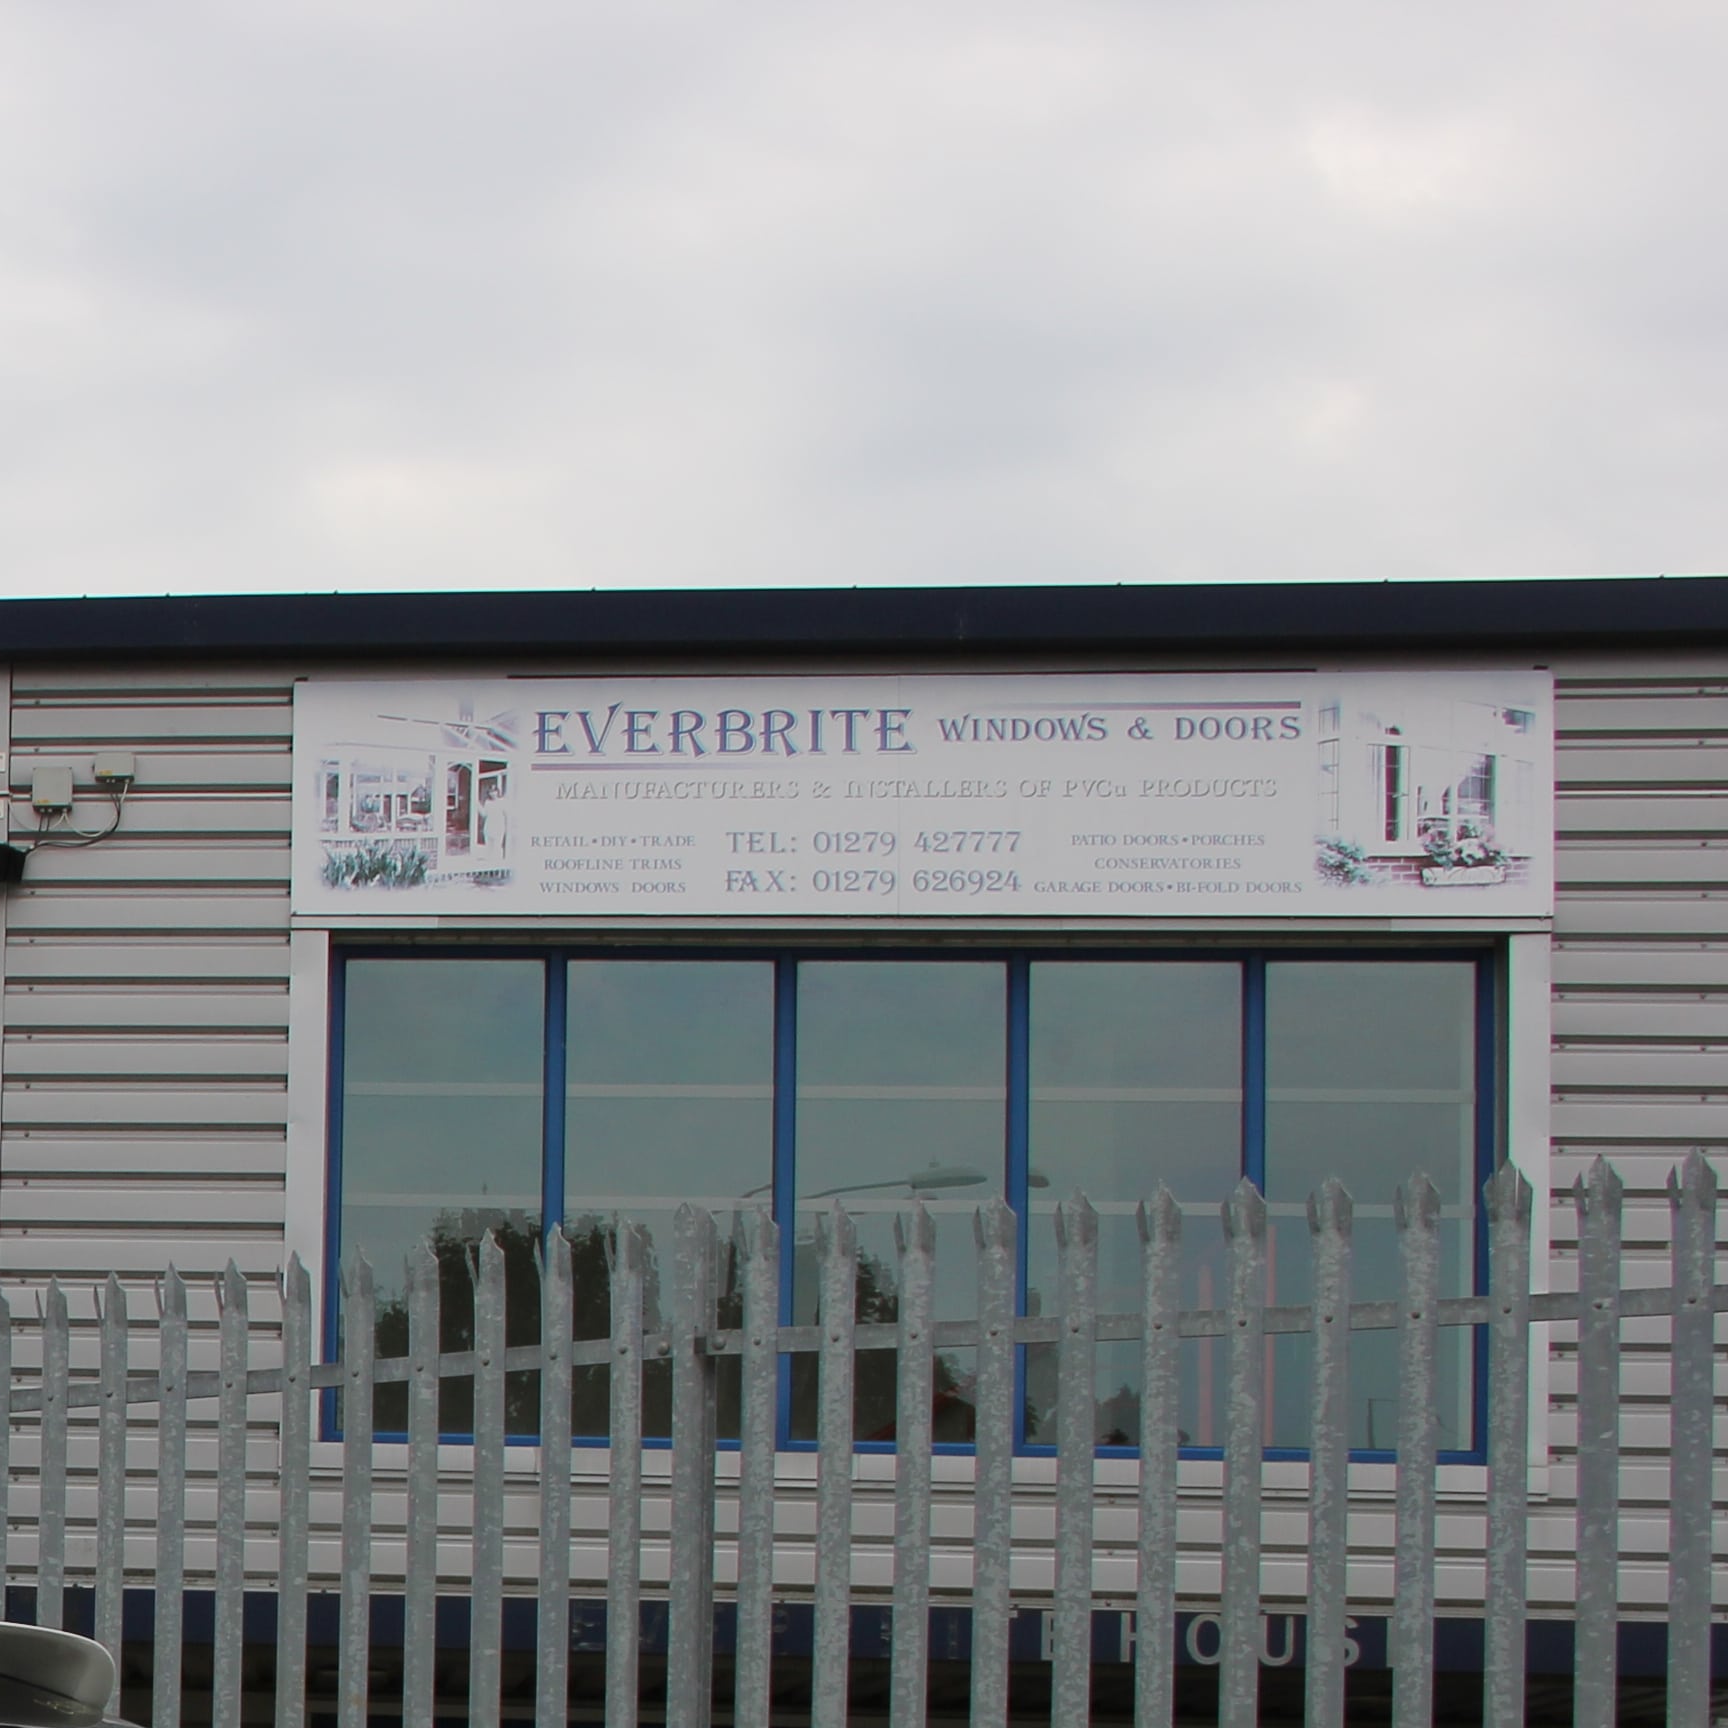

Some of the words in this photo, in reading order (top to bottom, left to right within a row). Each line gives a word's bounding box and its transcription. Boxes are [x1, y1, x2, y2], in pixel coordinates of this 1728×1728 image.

[533, 701, 915, 757] EVERBRITE
[938, 712, 1108, 742] WINDOWS
[1127, 715, 1153, 741] &
[1175, 715, 1302, 742] DOORS
[556, 781, 800, 800] MANUFACTURERS
[812, 780, 831, 799] &
[845, 778, 1008, 799] INSTALLERS
[1019, 778, 1051, 798] OF
[1141, 778, 1277, 798] PRODUCTS
[726, 831, 798, 854] TEL:
[813, 831, 896, 856] 01279
[914, 831, 1021, 854] 427777
[1071, 834, 1116, 846] PATIO
[1123, 834, 1179, 846] DOORS
[1192, 834, 1265, 846] PORCHES
[544, 858, 624, 871] ROOFLINE
[629, 858, 682, 871] TRIMS
[1094, 857, 1241, 870] CONSERVATORIES
[540, 881, 619, 894] WINDOWS
[631, 881, 686, 894] DOORS
[726, 869, 798, 893] FAX:
[813, 869, 896, 896] 01279
[913, 869, 1021, 895] 626924
[1034, 882, 1101, 894] GARAGE
[1108, 881, 1165, 894] DOORS
[1176, 881, 1239, 894] BI-FOLD
[1246, 881, 1302, 894] DOORS
